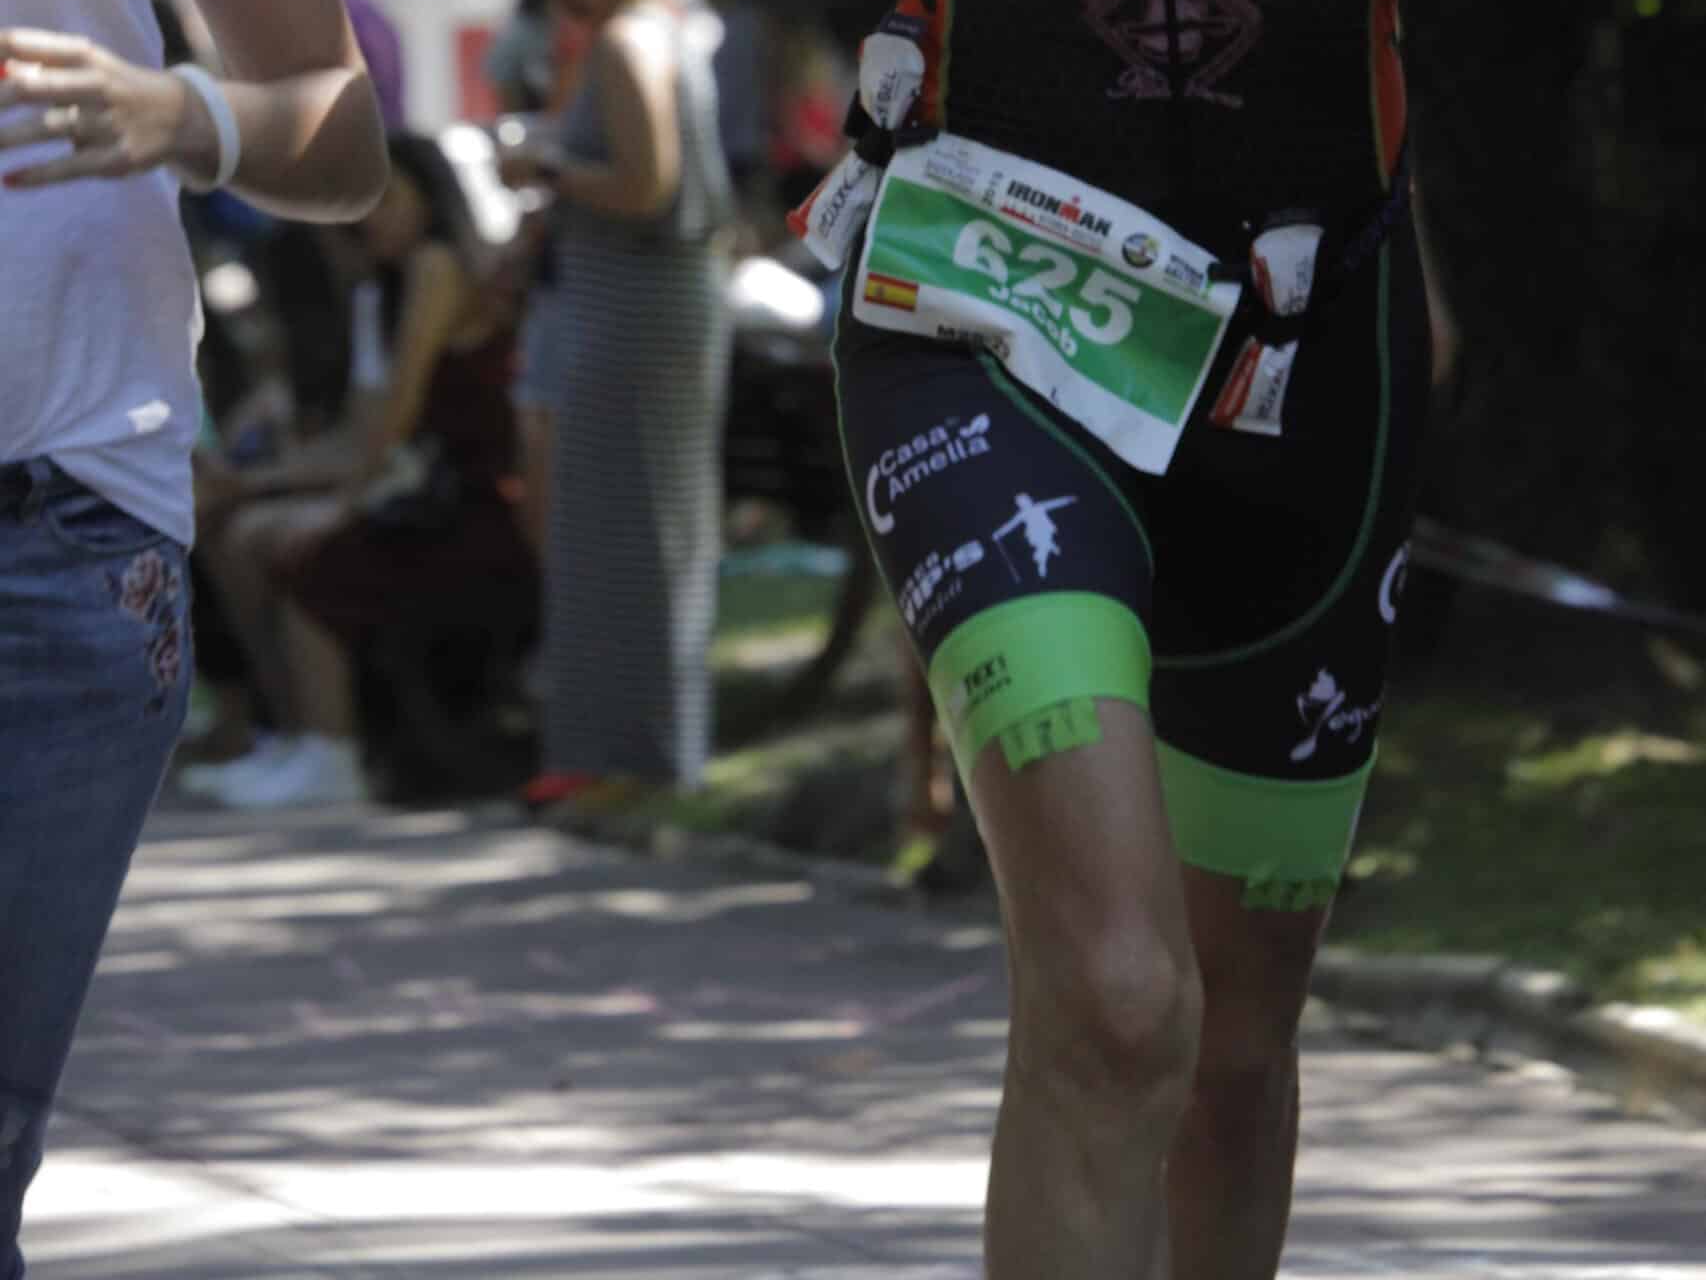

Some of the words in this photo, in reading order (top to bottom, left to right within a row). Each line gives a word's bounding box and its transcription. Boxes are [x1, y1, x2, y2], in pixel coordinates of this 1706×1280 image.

[1006, 178, 1114, 238] IRONMAN
[953, 219, 1143, 346] 625
[879, 425, 949, 476] Casa
